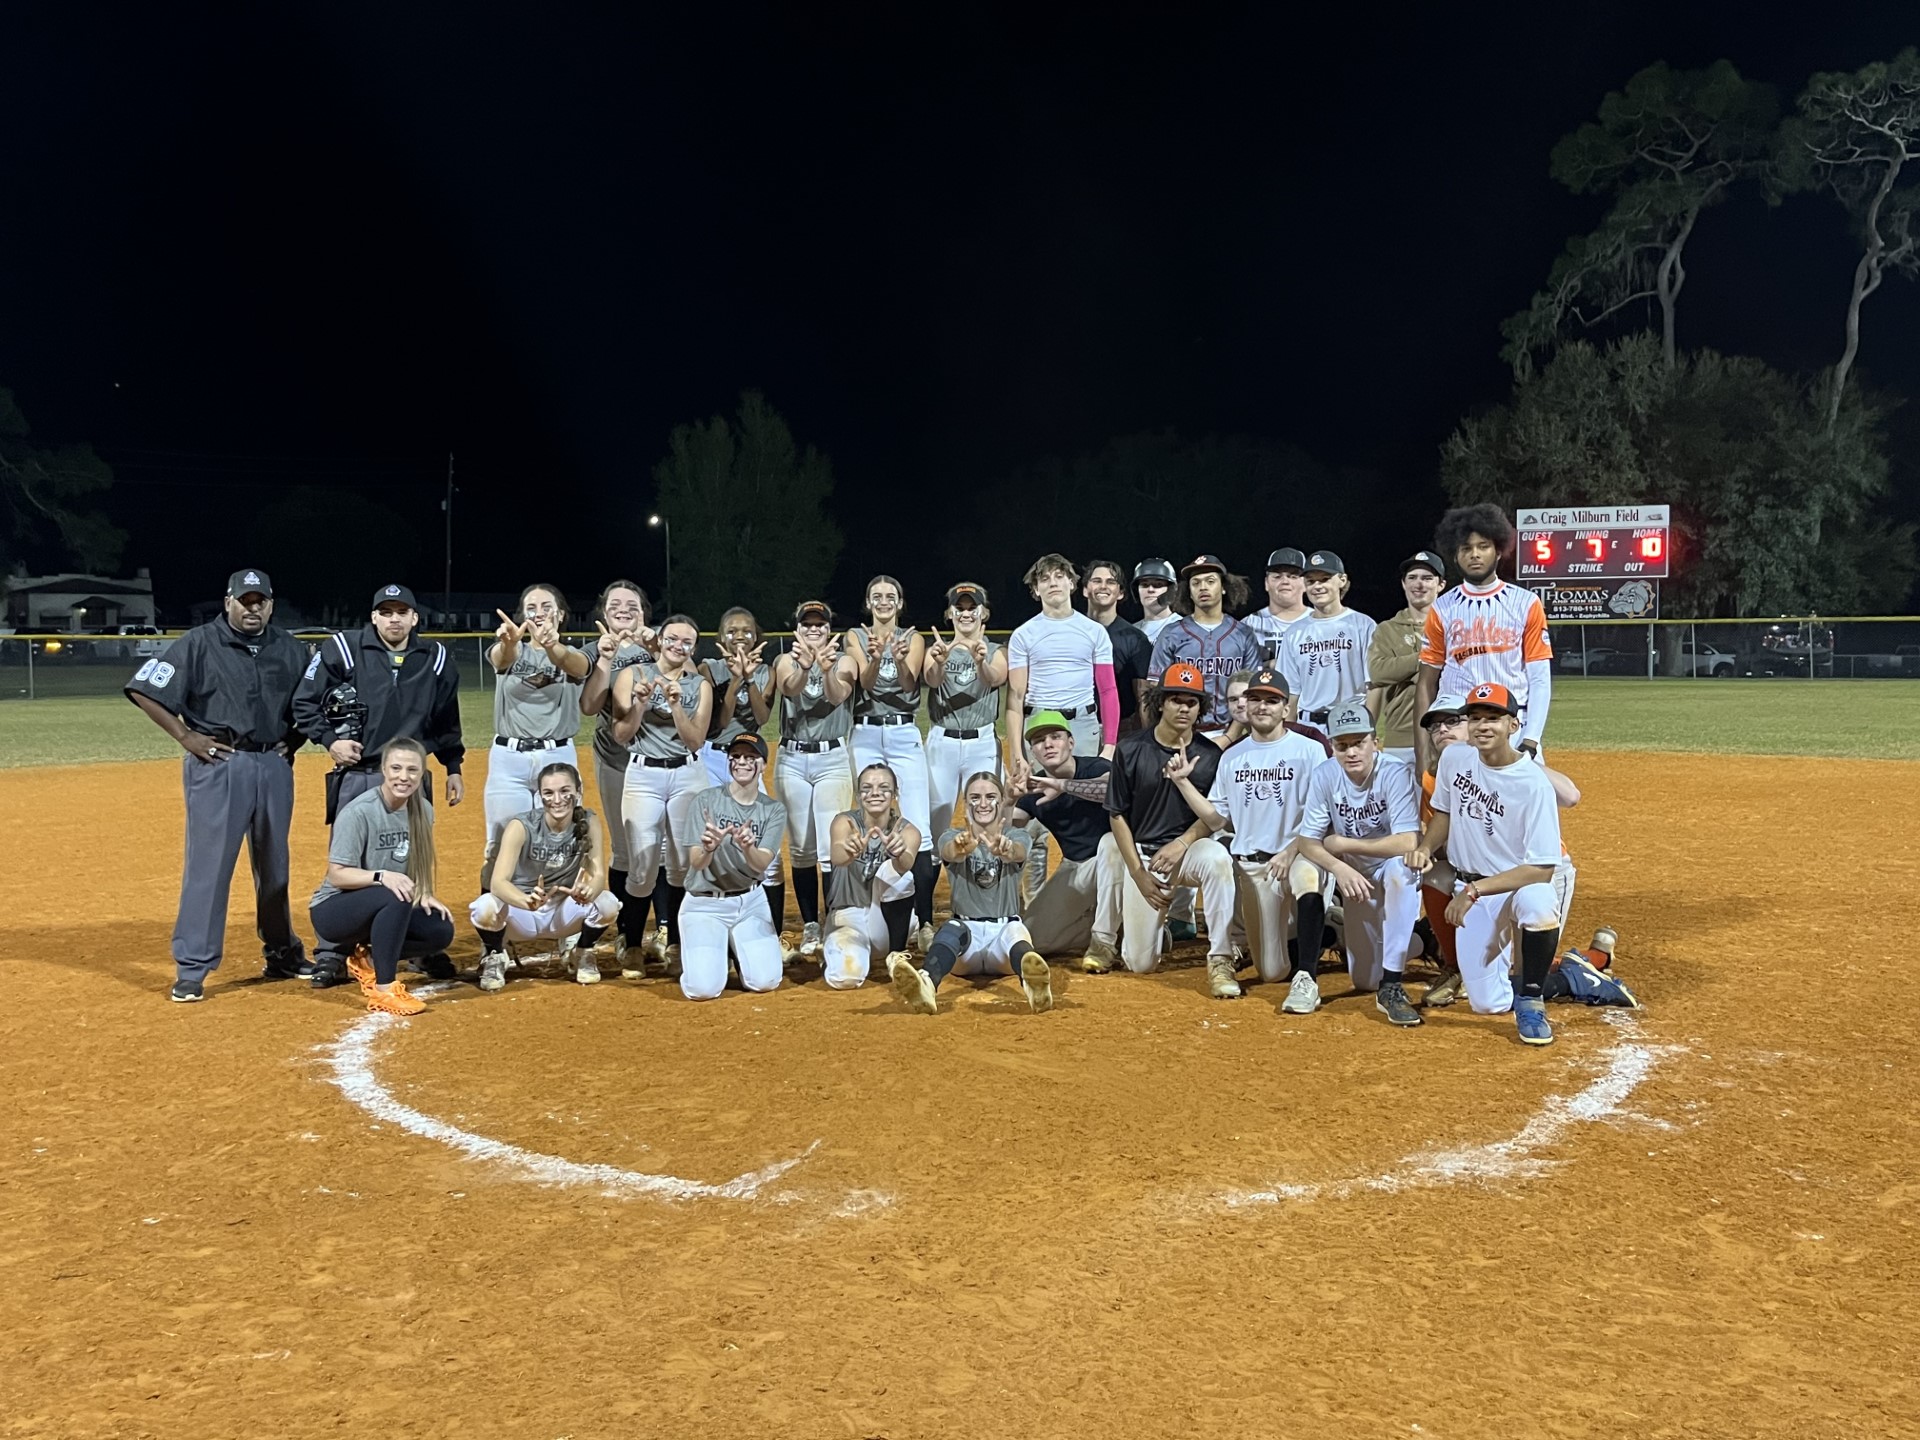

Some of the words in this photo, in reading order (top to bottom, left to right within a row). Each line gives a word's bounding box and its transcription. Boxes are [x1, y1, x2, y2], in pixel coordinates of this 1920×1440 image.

[1541, 511, 1566, 525] Craig
[1572, 511, 1610, 522] Milburn
[1616, 510, 1639, 521] Field
[1522, 532, 1553, 540] GUEST
[1575, 530, 1609, 539] INNING
[1633, 529, 1662, 538] HOME
[1536, 540, 1551, 559] 5
[1588, 539, 1602, 558] 7
[1642, 538, 1661, 556] 10
[1522, 565, 1546, 573] BALL
[1568, 564, 1603, 572] STRIKE
[1624, 562, 1644, 571] OUT
[136, 658, 175, 688] 88
[1235, 768, 1294, 783] ZEPHYRHILLS
